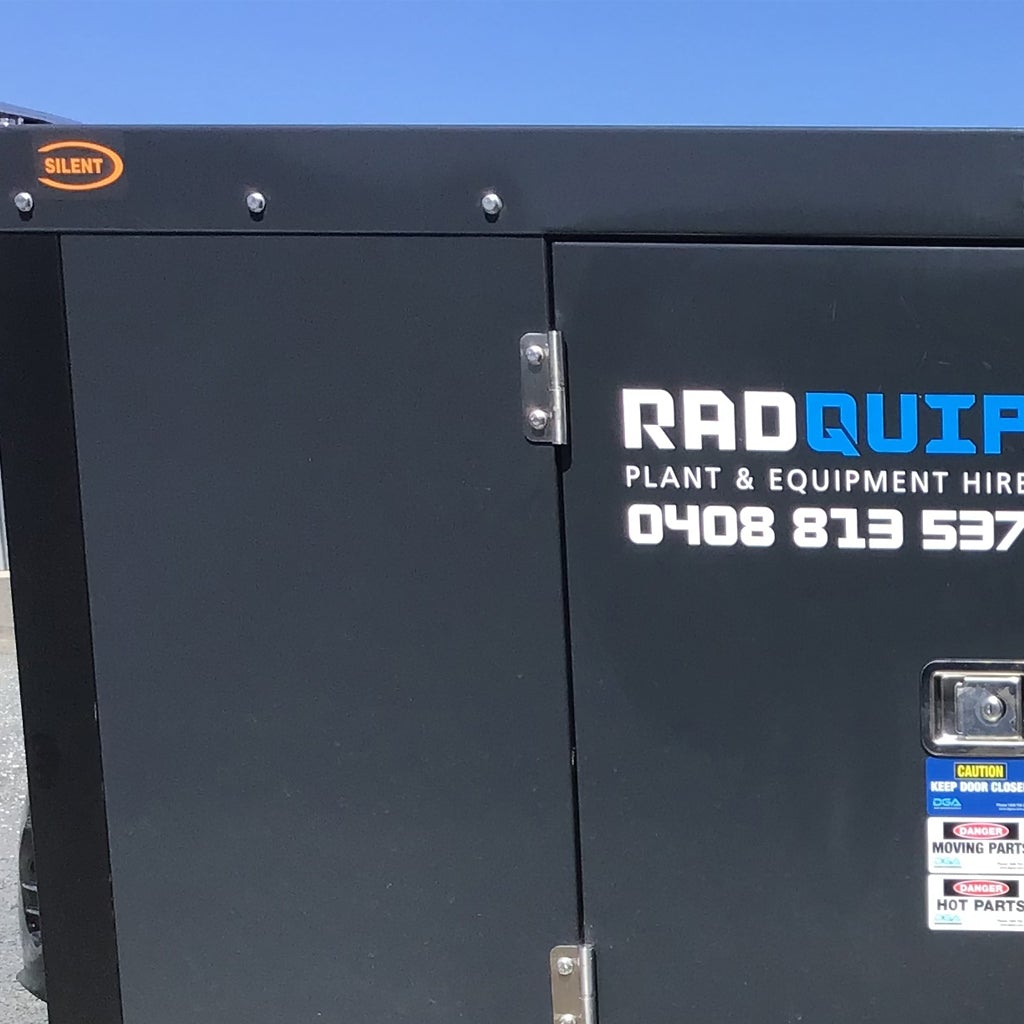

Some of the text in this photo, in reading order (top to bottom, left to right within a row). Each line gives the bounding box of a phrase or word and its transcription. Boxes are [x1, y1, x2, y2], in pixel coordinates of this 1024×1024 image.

[44, 157, 103, 174] SILENT
[625, 465, 721, 489] PLANT
[736, 467, 755, 491] &
[769, 468, 949, 495] EQUIPMENT
[627, 504, 776, 547] 0408
[792, 507, 905, 550] 813
[957, 764, 1004, 778] CAUTION
[930, 781, 958, 792] KEEP
[960, 781, 989, 793] DOOR
[933, 798, 962, 807] DGA
[959, 827, 1003, 836] DANGER
[932, 842, 984, 854] MOVING
[959, 884, 1004, 893] DANGER
[937, 899, 968, 911] HOT
